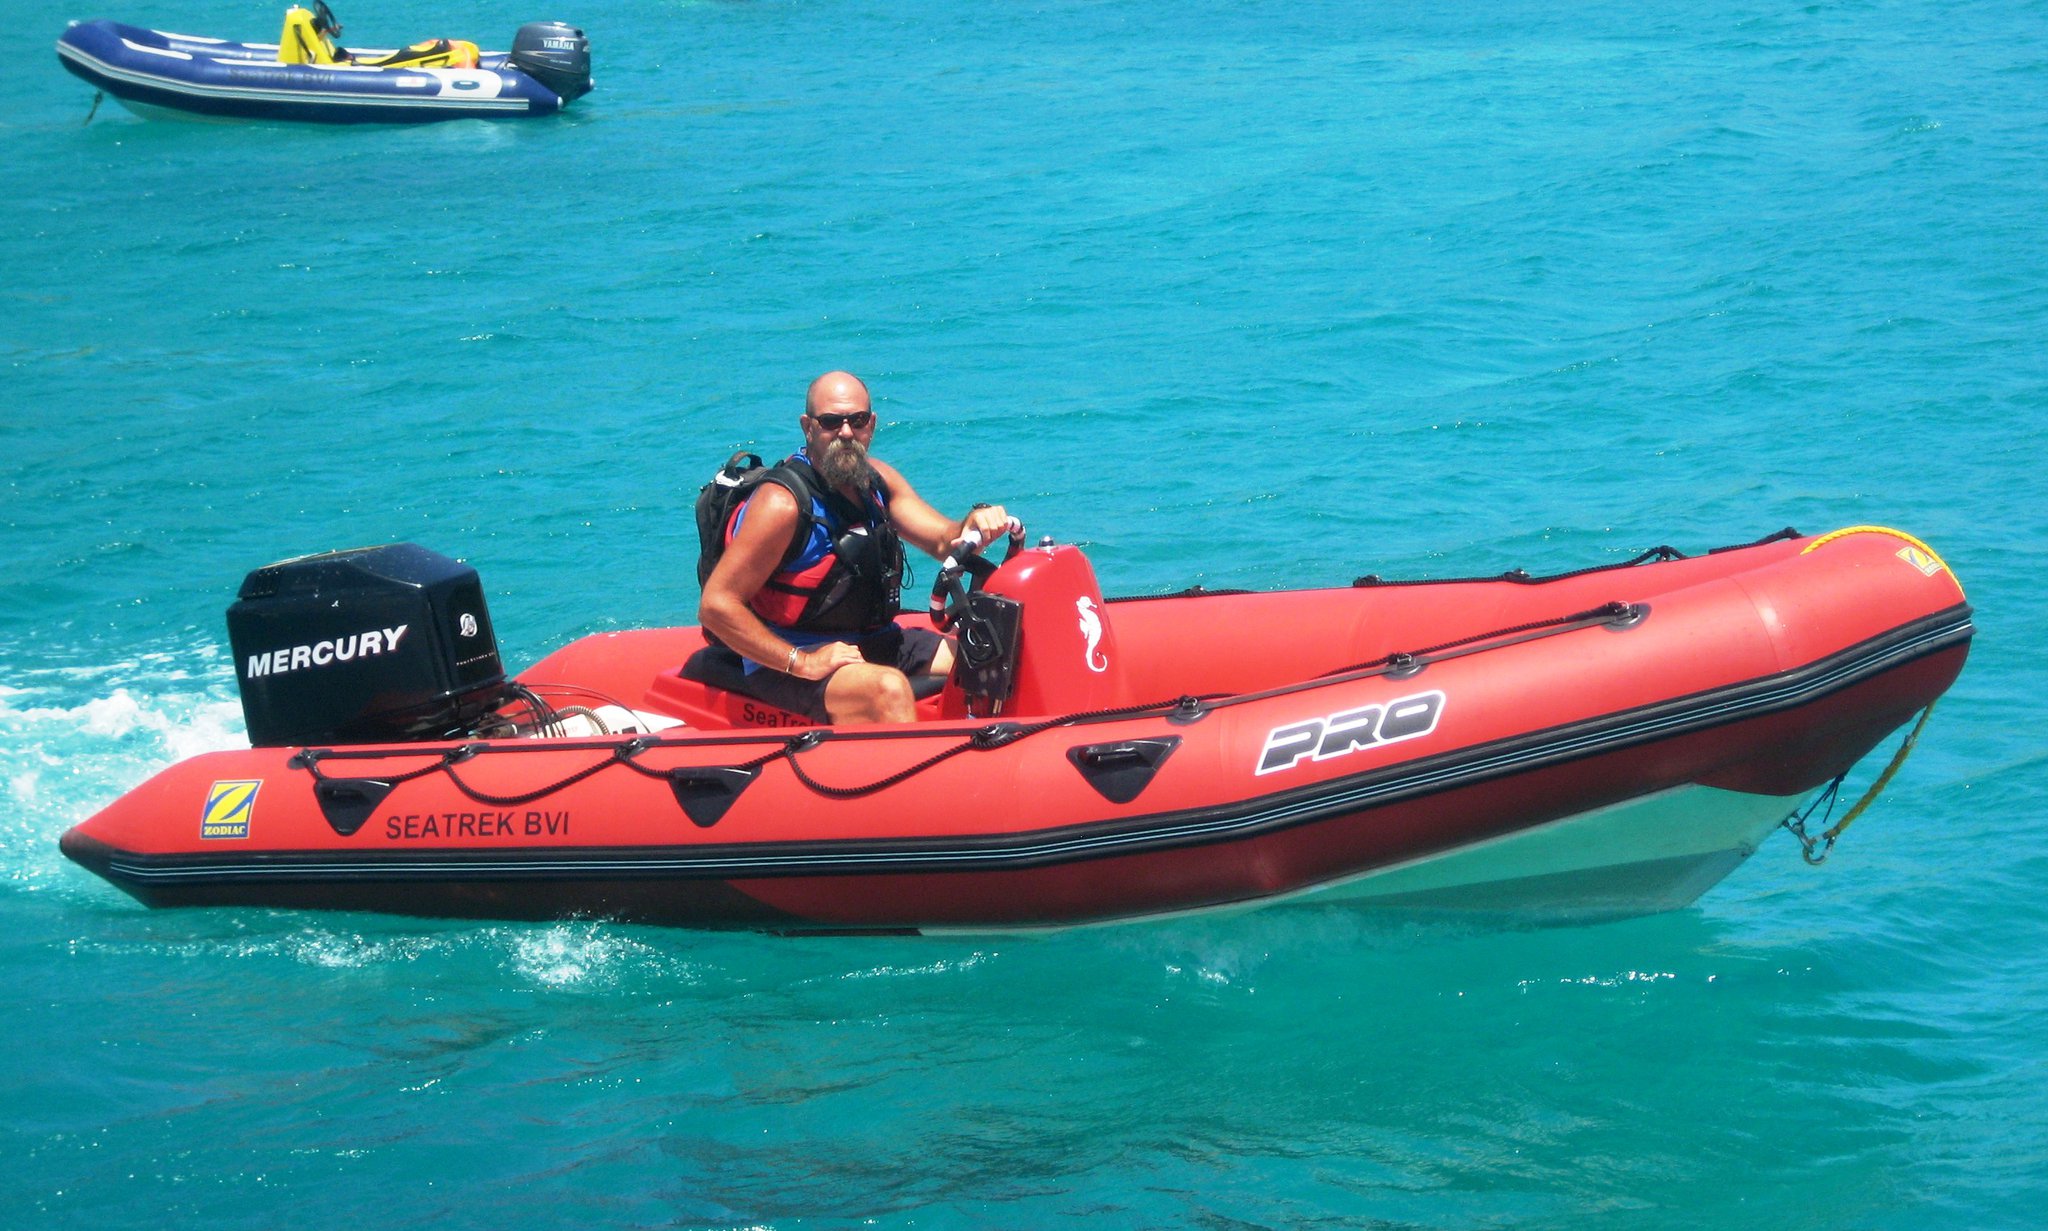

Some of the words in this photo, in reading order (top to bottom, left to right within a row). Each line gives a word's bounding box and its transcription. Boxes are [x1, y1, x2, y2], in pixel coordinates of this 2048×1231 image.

[542, 39, 575, 51] YAMAHA
[247, 624, 409, 679] MERCURY
[742, 702, 815, 728] SeaTr
[1254, 689, 1447, 777] PRO
[203, 825, 246, 836] ZODIAC
[385, 812, 515, 840] SEATREK
[524, 811, 570, 836] BVI
